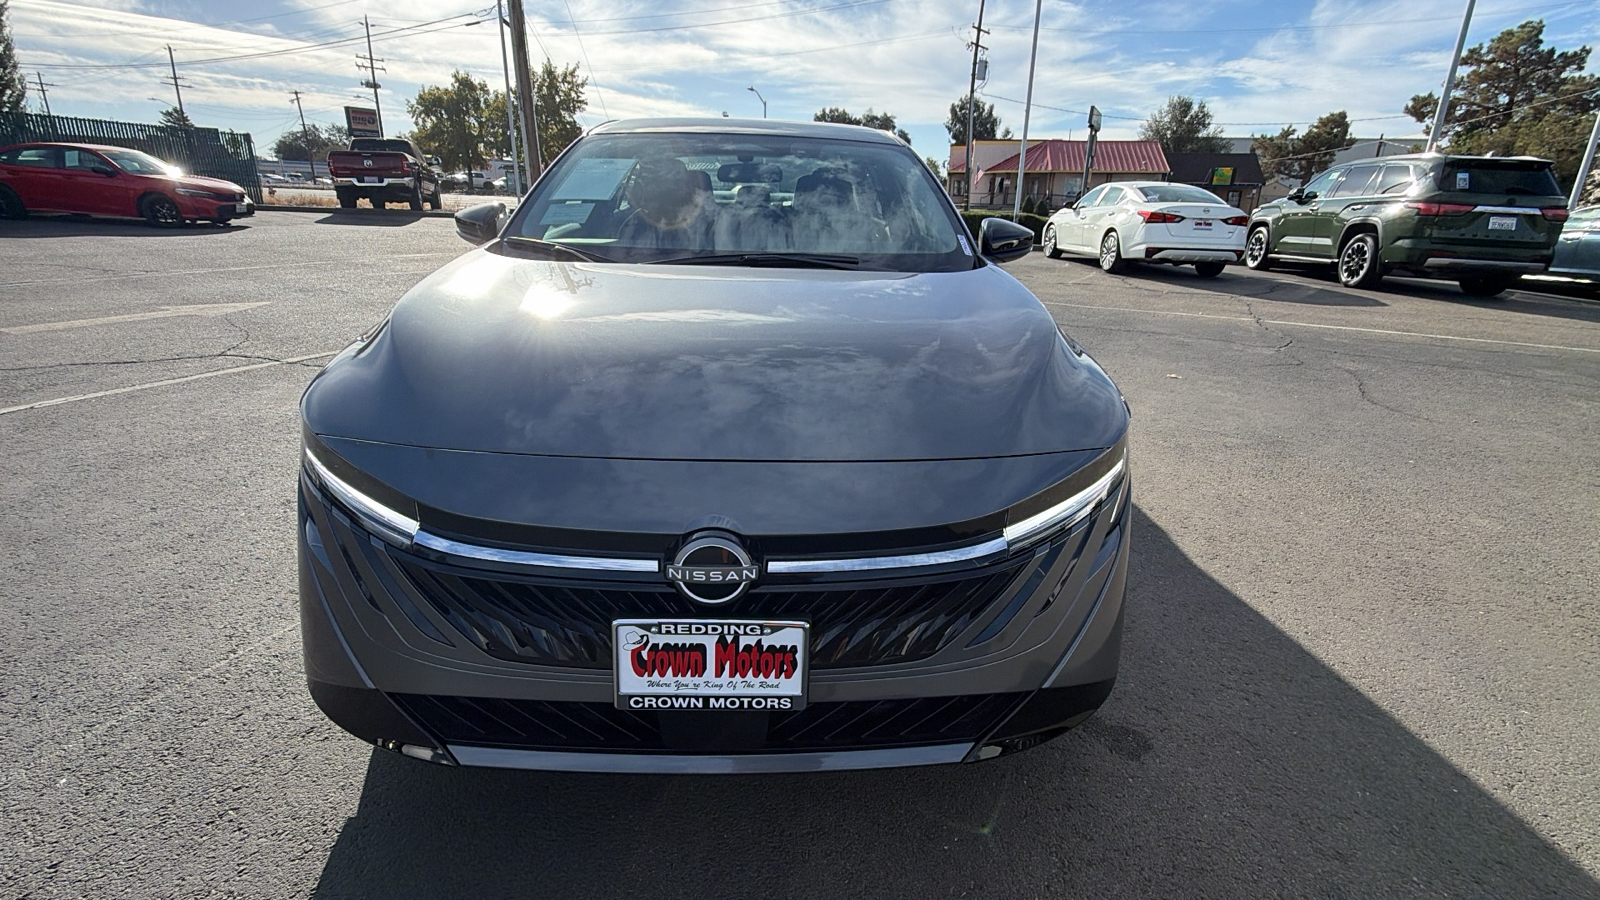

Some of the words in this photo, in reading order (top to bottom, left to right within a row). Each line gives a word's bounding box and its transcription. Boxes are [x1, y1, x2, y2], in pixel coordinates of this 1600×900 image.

[668, 568, 757, 582] NISSAN
[660, 624, 762, 635] REDDING
[630, 641, 707, 678] Crown
[714, 635, 799, 679] Motors
[646, 680, 672, 688] Where
[673, 680, 700, 691] You're
[703, 680, 724, 691] King
[726, 680, 738, 690] Of
[740, 680, 756, 689] The
[758, 681, 781, 689] Road
[629, 697, 703, 709] CROWN
[709, 697, 792, 709] MOTORS
